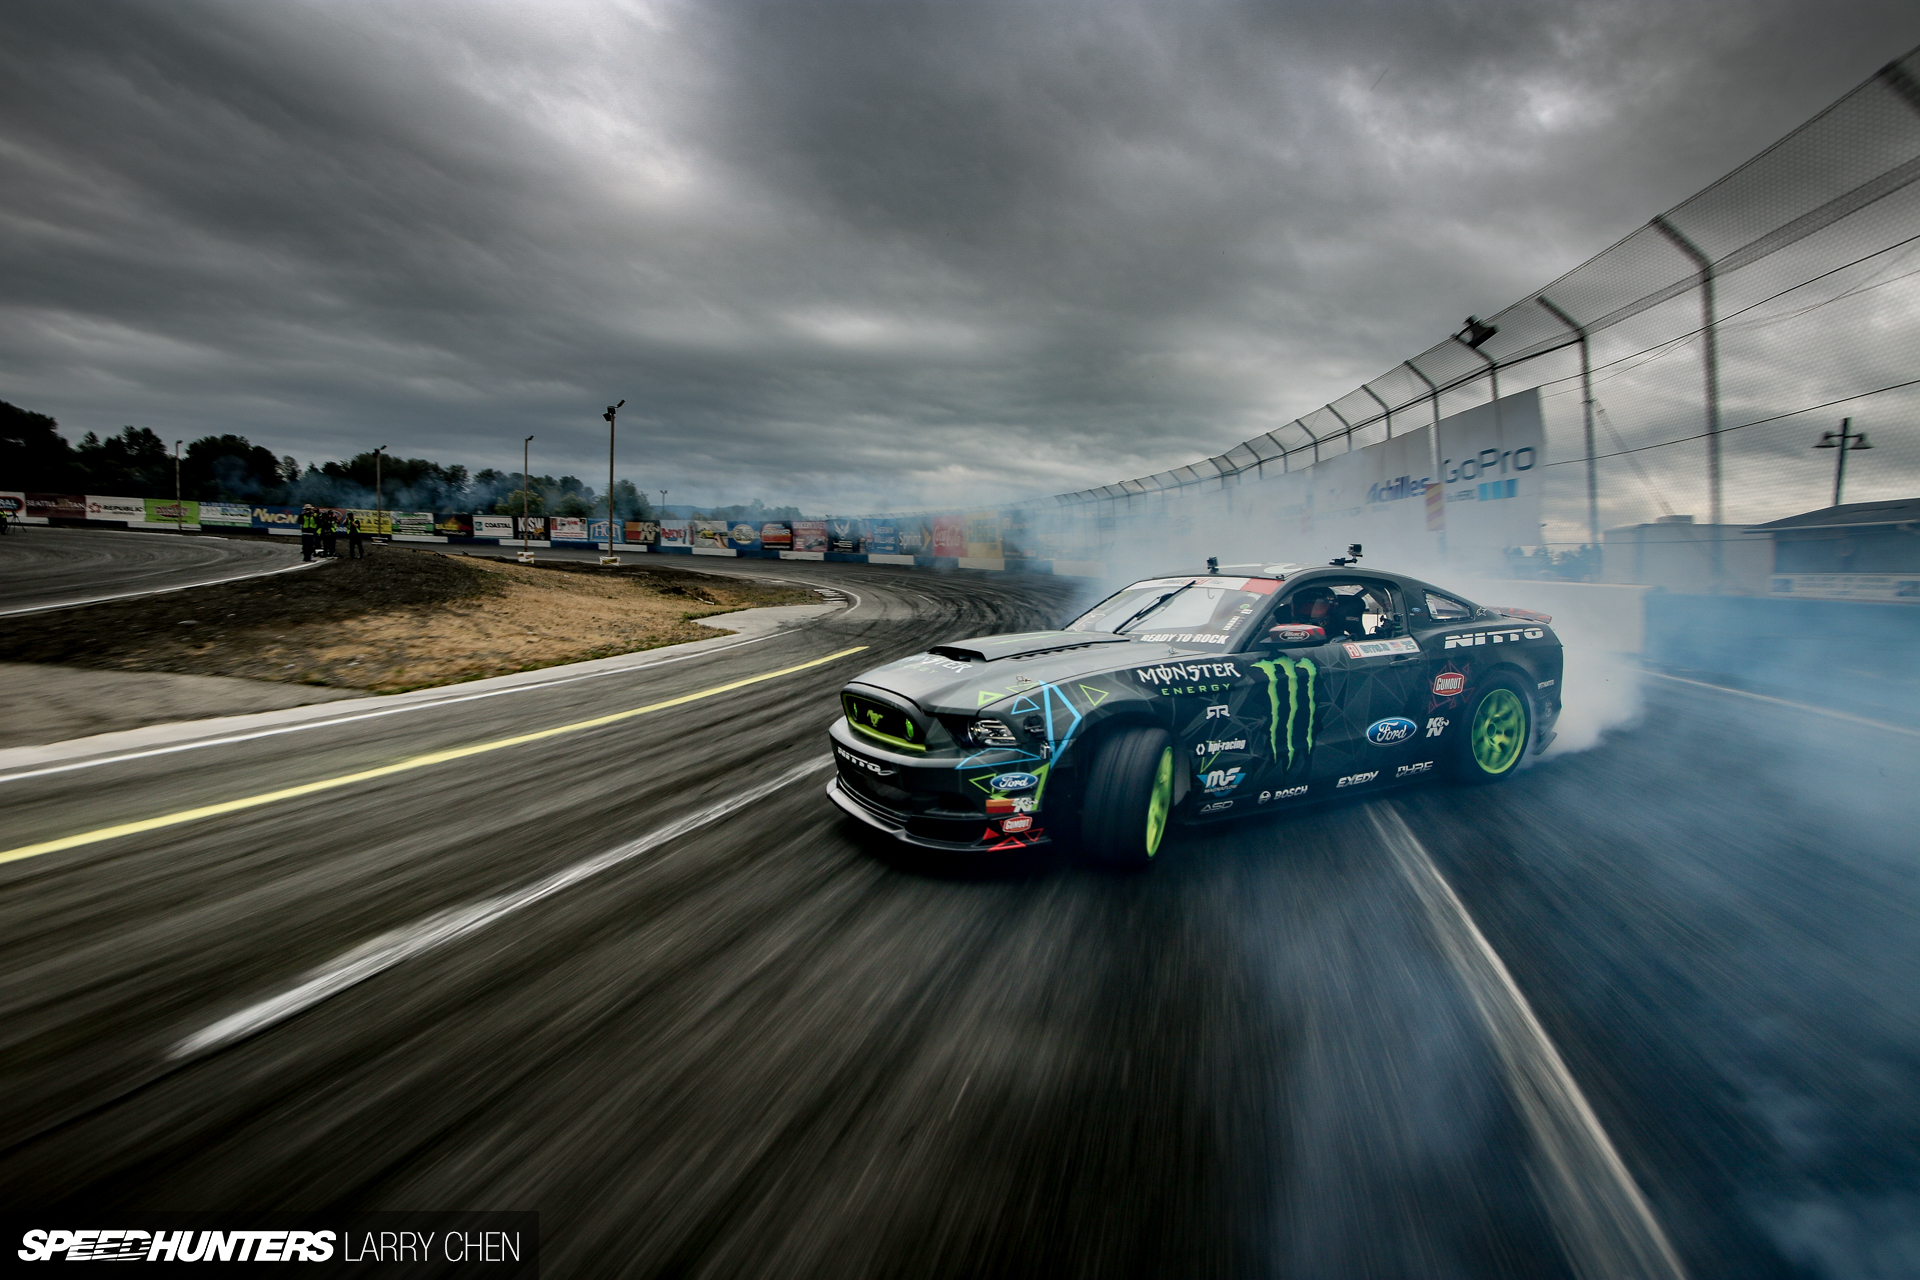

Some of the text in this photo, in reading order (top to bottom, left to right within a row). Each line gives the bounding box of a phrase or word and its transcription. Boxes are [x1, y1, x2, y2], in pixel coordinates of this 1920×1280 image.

[1443, 446, 1537, 484] GoPro
[1366, 474, 1430, 504] Achilles
[253, 508, 299, 525] NWCN
[899, 532, 923, 551] Sprint
[1140, 633, 1230, 645] READY TO ROCK
[1444, 627, 1544, 650] NITTO
[1136, 662, 1242, 685] MONSTER
[1161, 683, 1231, 696] ENERGY
[1435, 677, 1463, 692] GUMOUT
[1205, 704, 1231, 720] RTR
[1376, 721, 1408, 743] Ford
[1426, 717, 1450, 738] K&N
[1207, 738, 1247, 755] hpi-racing
[837, 746, 883, 773] NITTO
[999, 775, 1029, 788] Ford
[1204, 766, 1242, 789] MF
[1335, 770, 1380, 789] EXEDY
[1273, 784, 1309, 801] BOSCH
[1198, 800, 1234, 814] ASD
[1005, 818, 1030, 830] GUMOUT
